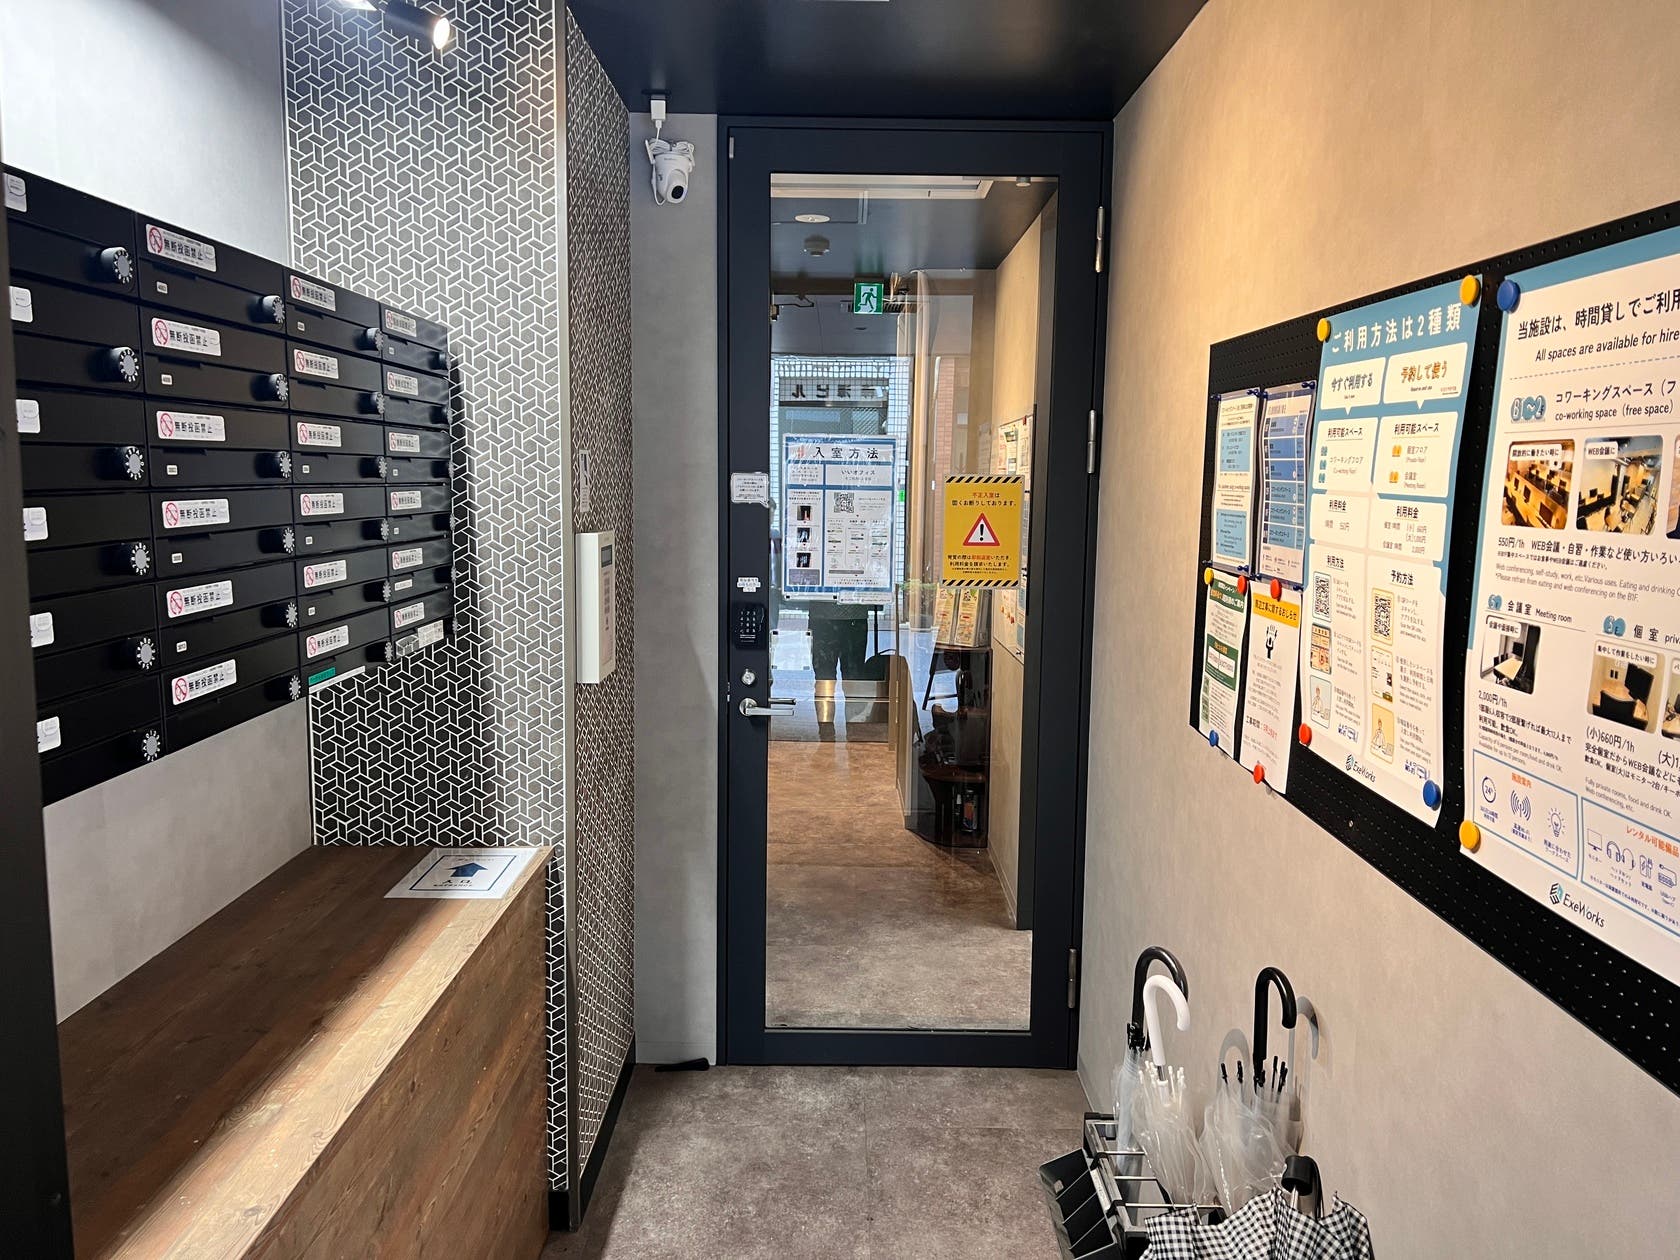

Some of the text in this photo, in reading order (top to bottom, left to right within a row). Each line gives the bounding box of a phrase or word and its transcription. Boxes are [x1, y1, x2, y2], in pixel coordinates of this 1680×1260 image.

[1518, 288, 1680, 340] 当施設は、時間貸しでご利用
[1332, 303, 1461, 353] ご利用方法は2種類
[1535, 328, 1680, 362] All spaces are available for hire
[1401, 361, 1447, 383] 予約して使う
[1331, 372, 1373, 393] 今すぐ利用する
[1555, 408, 1594, 421] co-working
[1595, 406, 1617, 419] space
[1327, 427, 1363, 439] 利用可能スペース
[1394, 423, 1440, 436] 利用可能スペース
[813, 447, 879, 459] 入室方法
[1588, 446, 1615, 456] WEB会議に
[1329, 500, 1347, 511] 利用料金
[1396, 505, 1419, 519] 利用料金
[1327, 555, 1344, 569] 利用方法
[1532, 540, 1680, 565] WEB会議・自習・作業など使い方いろい
[1391, 569, 1414, 587] 予約方法
[1574, 586, 1608, 599] conferencing
[1617, 591, 1626, 601] the
[1619, 580, 1638, 592] Eating
[1638, 584, 1650, 592] and
[1651, 585, 1676, 598] drinking
[1507, 600, 1573, 623] 会議室 Meeting room
[1634, 624, 1680, 644] 個室 priv
[1597, 645, 1655, 664] 集中して作業をしたい時に
[1586, 726, 1635, 753] (小)660円/1h
[1353, 761, 1376, 783] ExeWorks
[1562, 893, 1606, 928] ExeWorks
